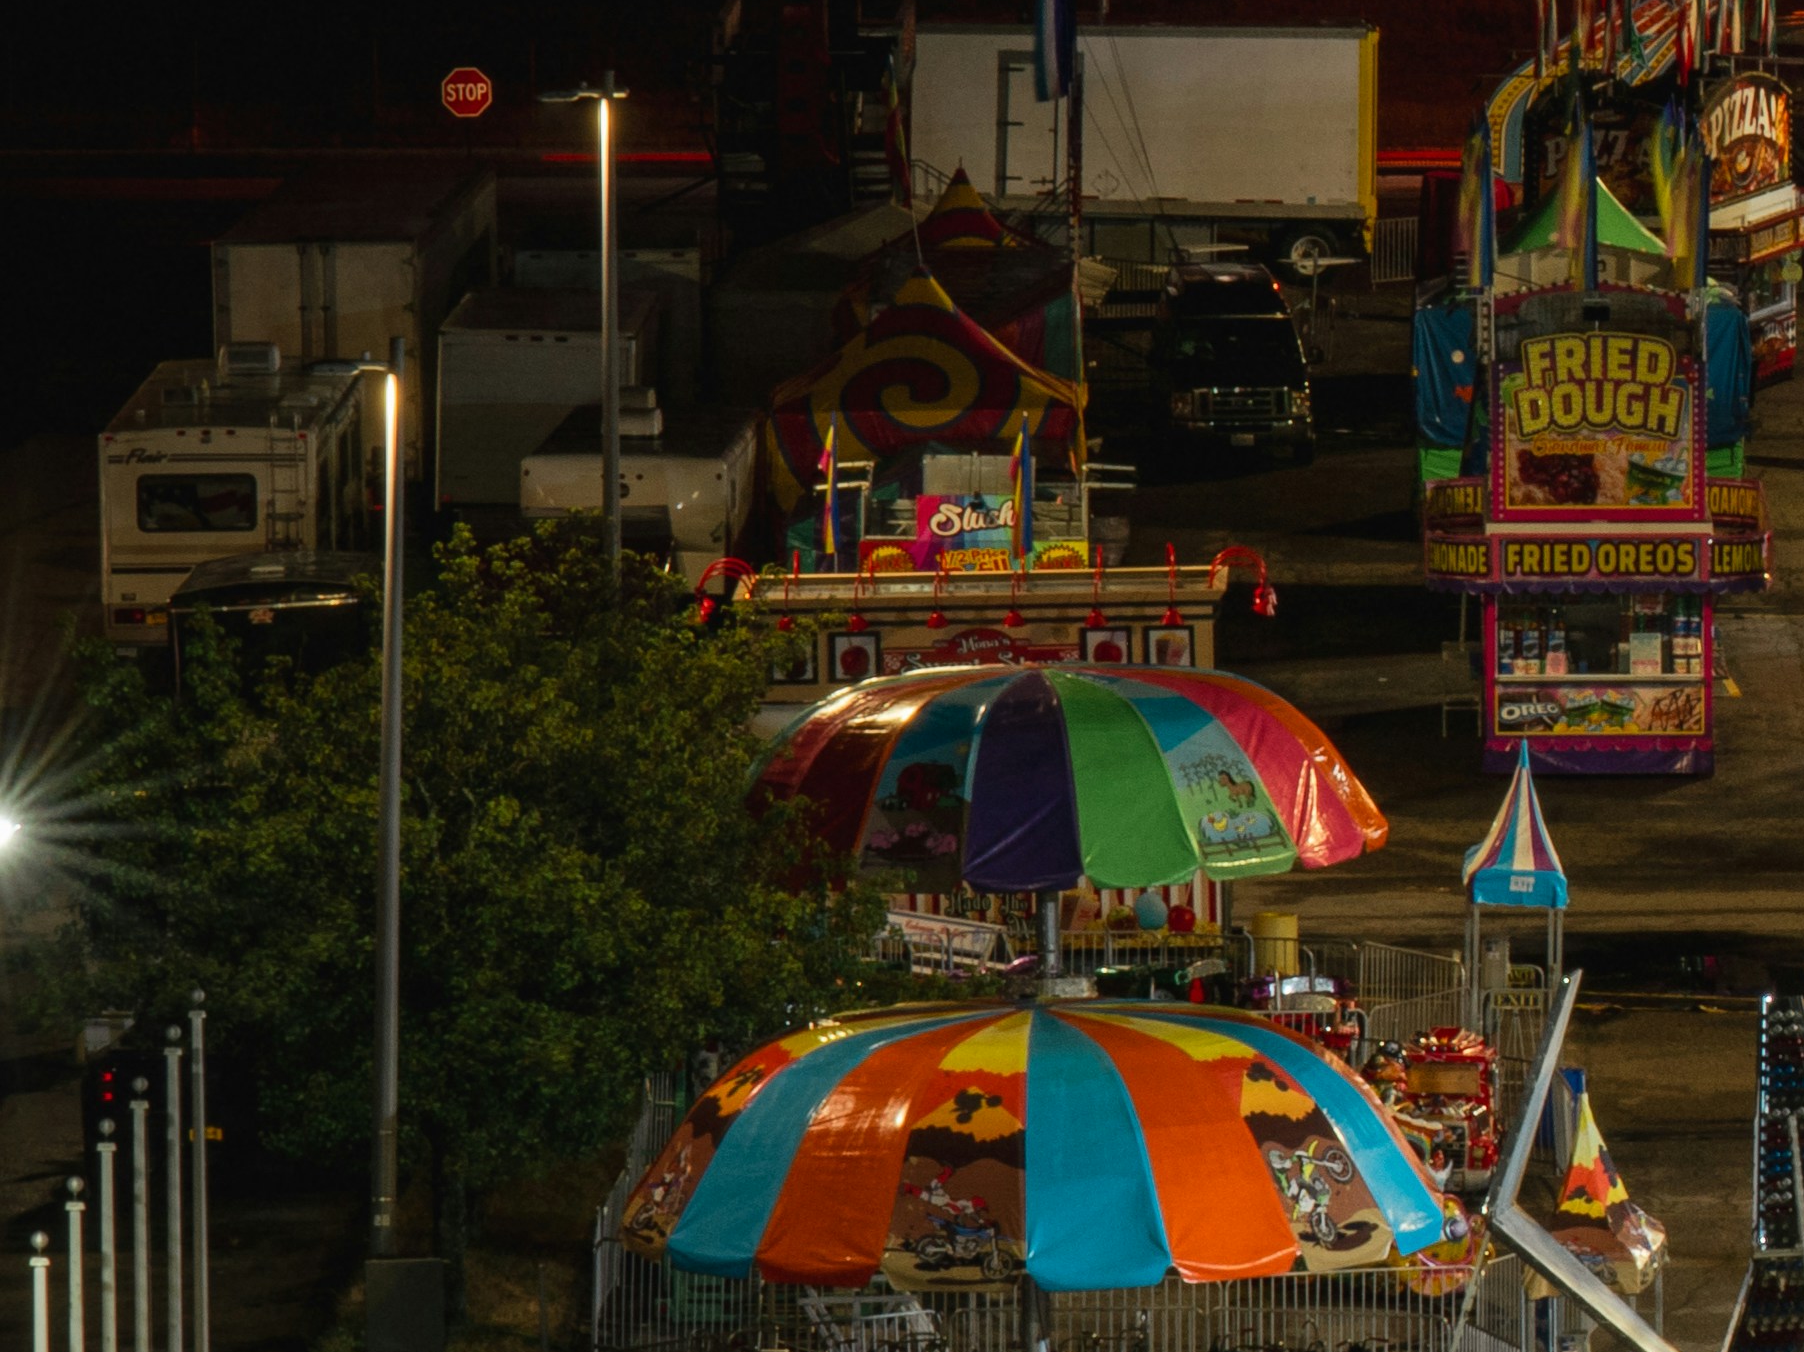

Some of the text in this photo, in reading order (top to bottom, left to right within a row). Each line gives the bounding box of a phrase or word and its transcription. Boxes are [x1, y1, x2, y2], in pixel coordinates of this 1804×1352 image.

[446, 83, 488, 102] STOP
[1710, 87, 1778, 161] PIZZA!
[1526, 335, 1672, 386] FRIED
[1518, 381, 1683, 436] DOUGH
[929, 499, 1017, 536] Slush
[1505, 543, 1696, 574] FRIED OREOS
[1712, 543, 1765, 574] LEMON
[1501, 701, 1562, 721] OREO
